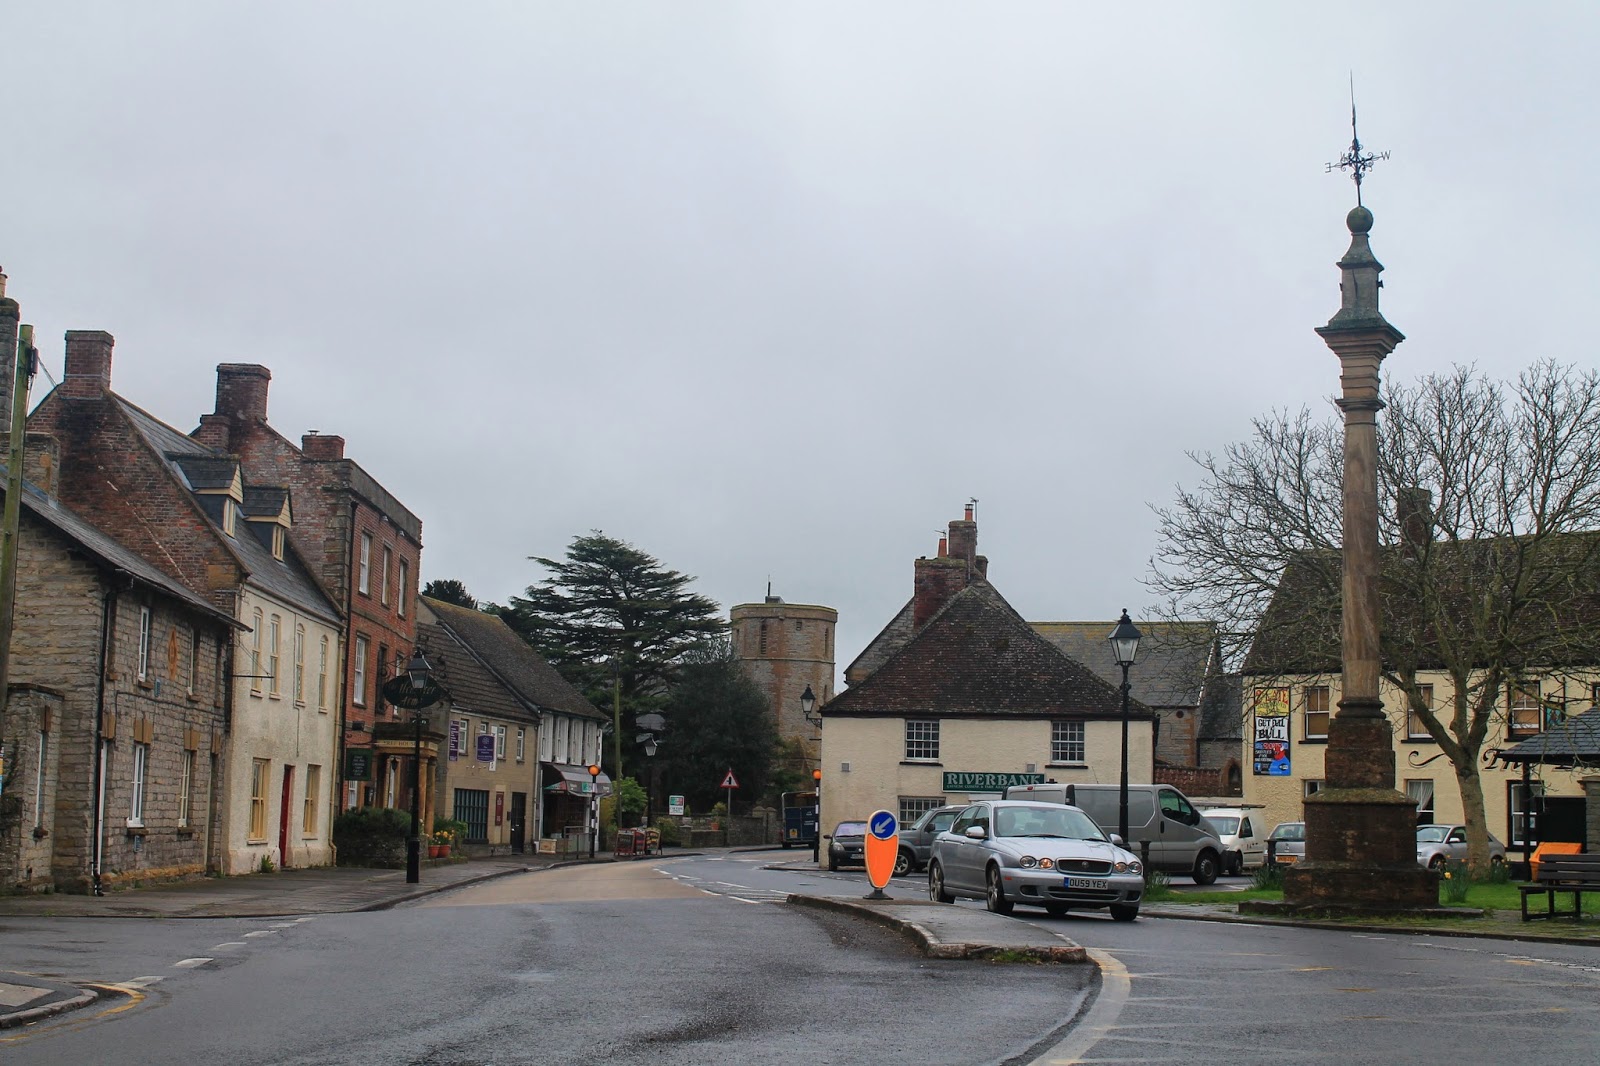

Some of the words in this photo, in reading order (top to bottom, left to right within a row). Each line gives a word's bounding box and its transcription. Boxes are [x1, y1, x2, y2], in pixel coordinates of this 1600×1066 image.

[1380, 150, 1391, 161] W
[1258, 729, 1285, 740] BULL
[946, 773, 1041, 786] RIVERBANK
[1070, 878, 1090, 888] OU59
[1092, 880, 1107, 888] YEX
